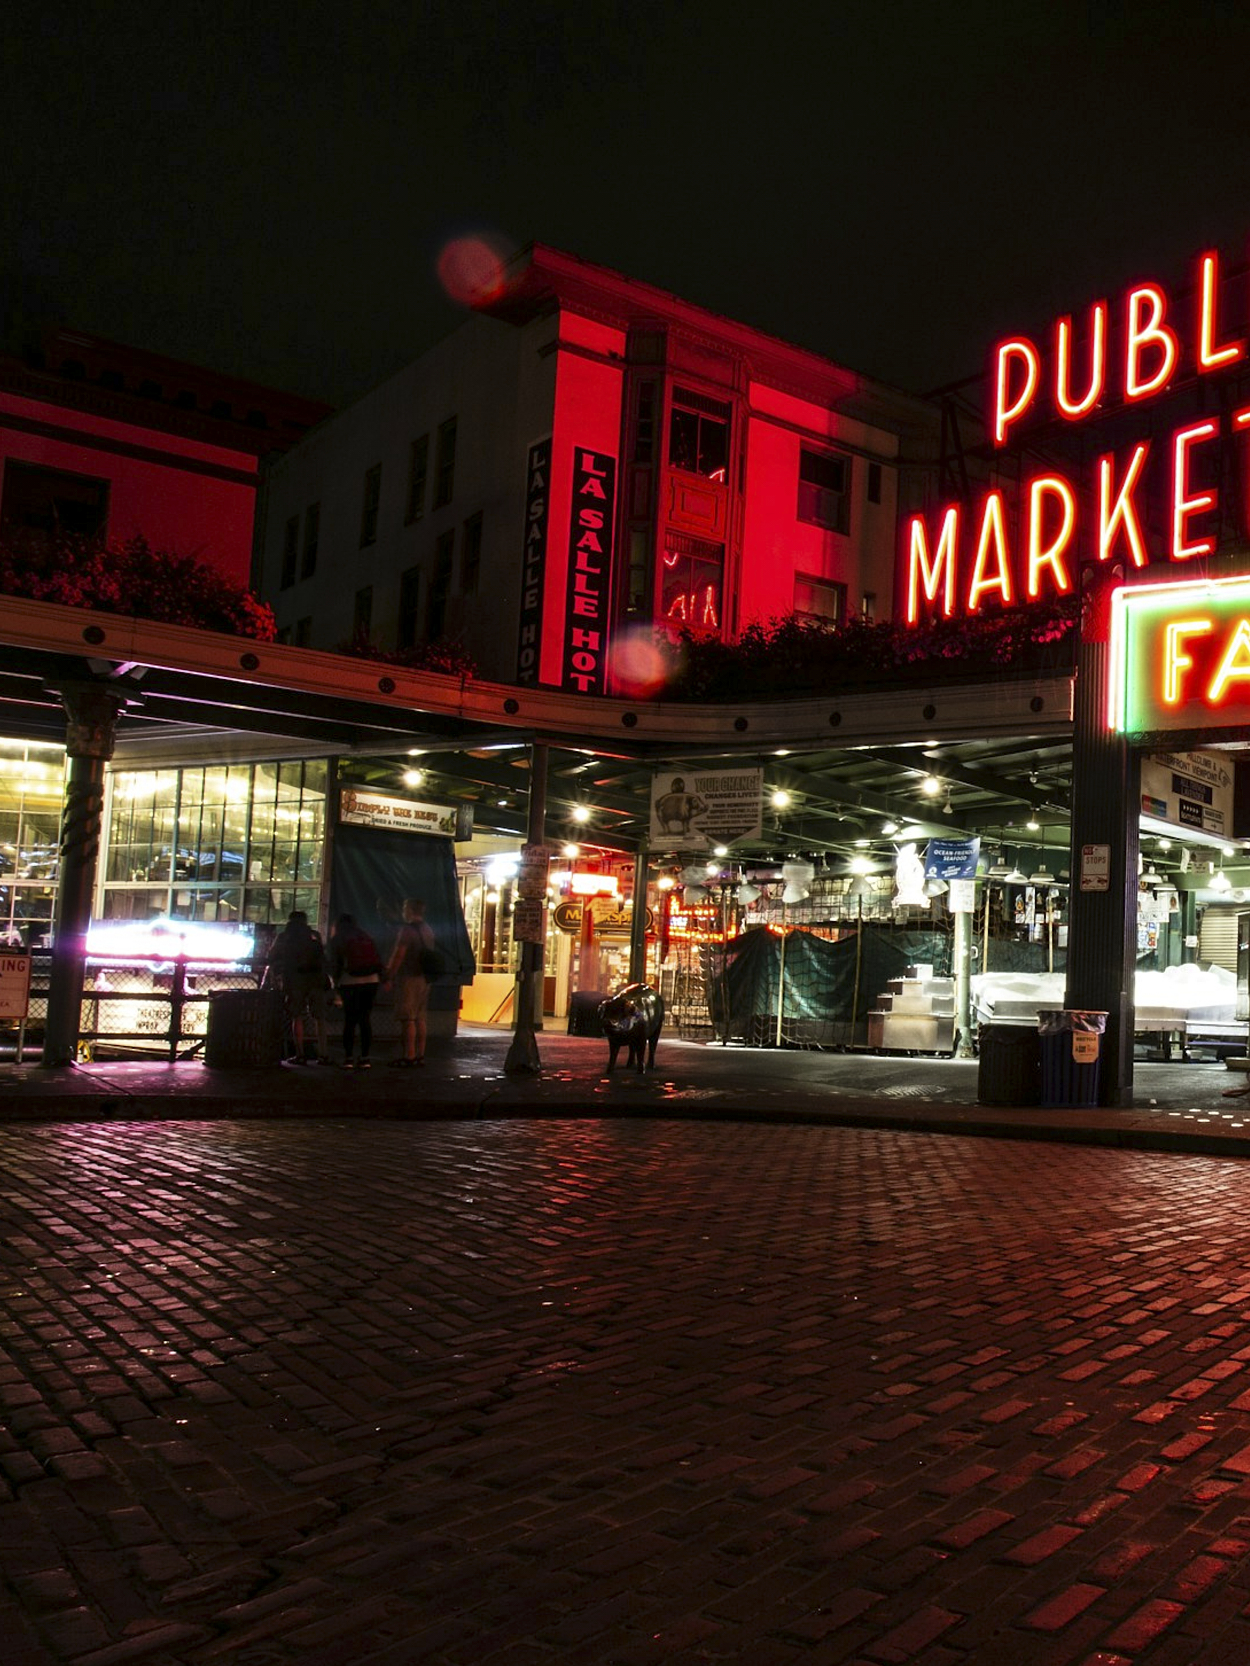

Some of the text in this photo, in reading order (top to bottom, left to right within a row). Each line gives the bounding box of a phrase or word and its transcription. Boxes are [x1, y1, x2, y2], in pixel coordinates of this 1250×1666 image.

[524, 498, 544, 611] SALLE
[569, 452, 607, 692] LA SALLE HOT
[695, 775, 761, 793] YOUR CHANGE
[410, 821, 432, 830] PRODUCE
[1086, 857, 1107, 865] STOPS
